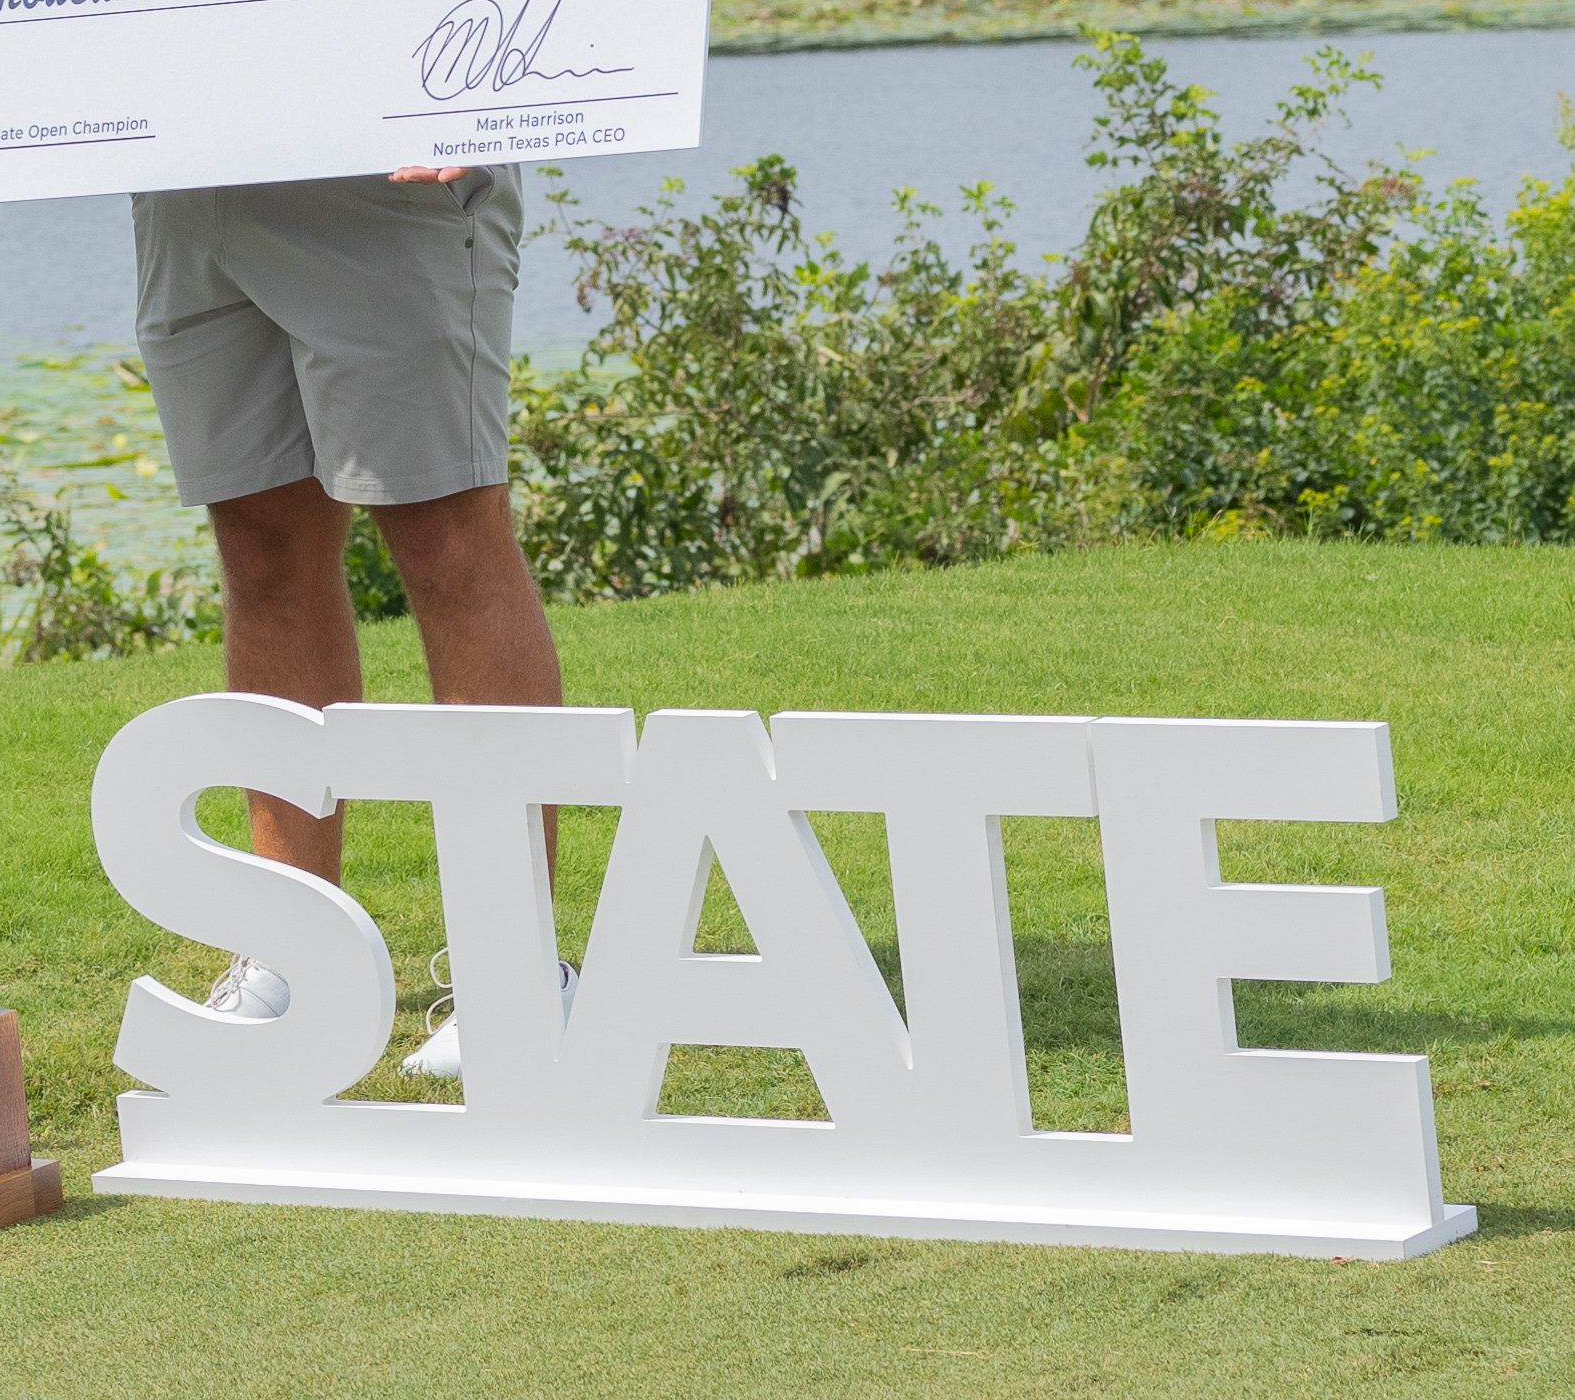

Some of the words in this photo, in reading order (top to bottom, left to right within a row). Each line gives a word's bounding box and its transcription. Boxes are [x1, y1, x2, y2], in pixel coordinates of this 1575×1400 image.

[28, 123, 68, 140] Open
[72, 116, 149, 136] Champion
[476, 114, 515, 132] Mark
[519, 110, 585, 129] Harrison
[433, 139, 503, 157] Northern
[508, 133, 550, 151] Texas
[554, 129, 588, 147] PGA
[592, 126, 626, 144] CEO
[91, 690, 1430, 1225] STATE
